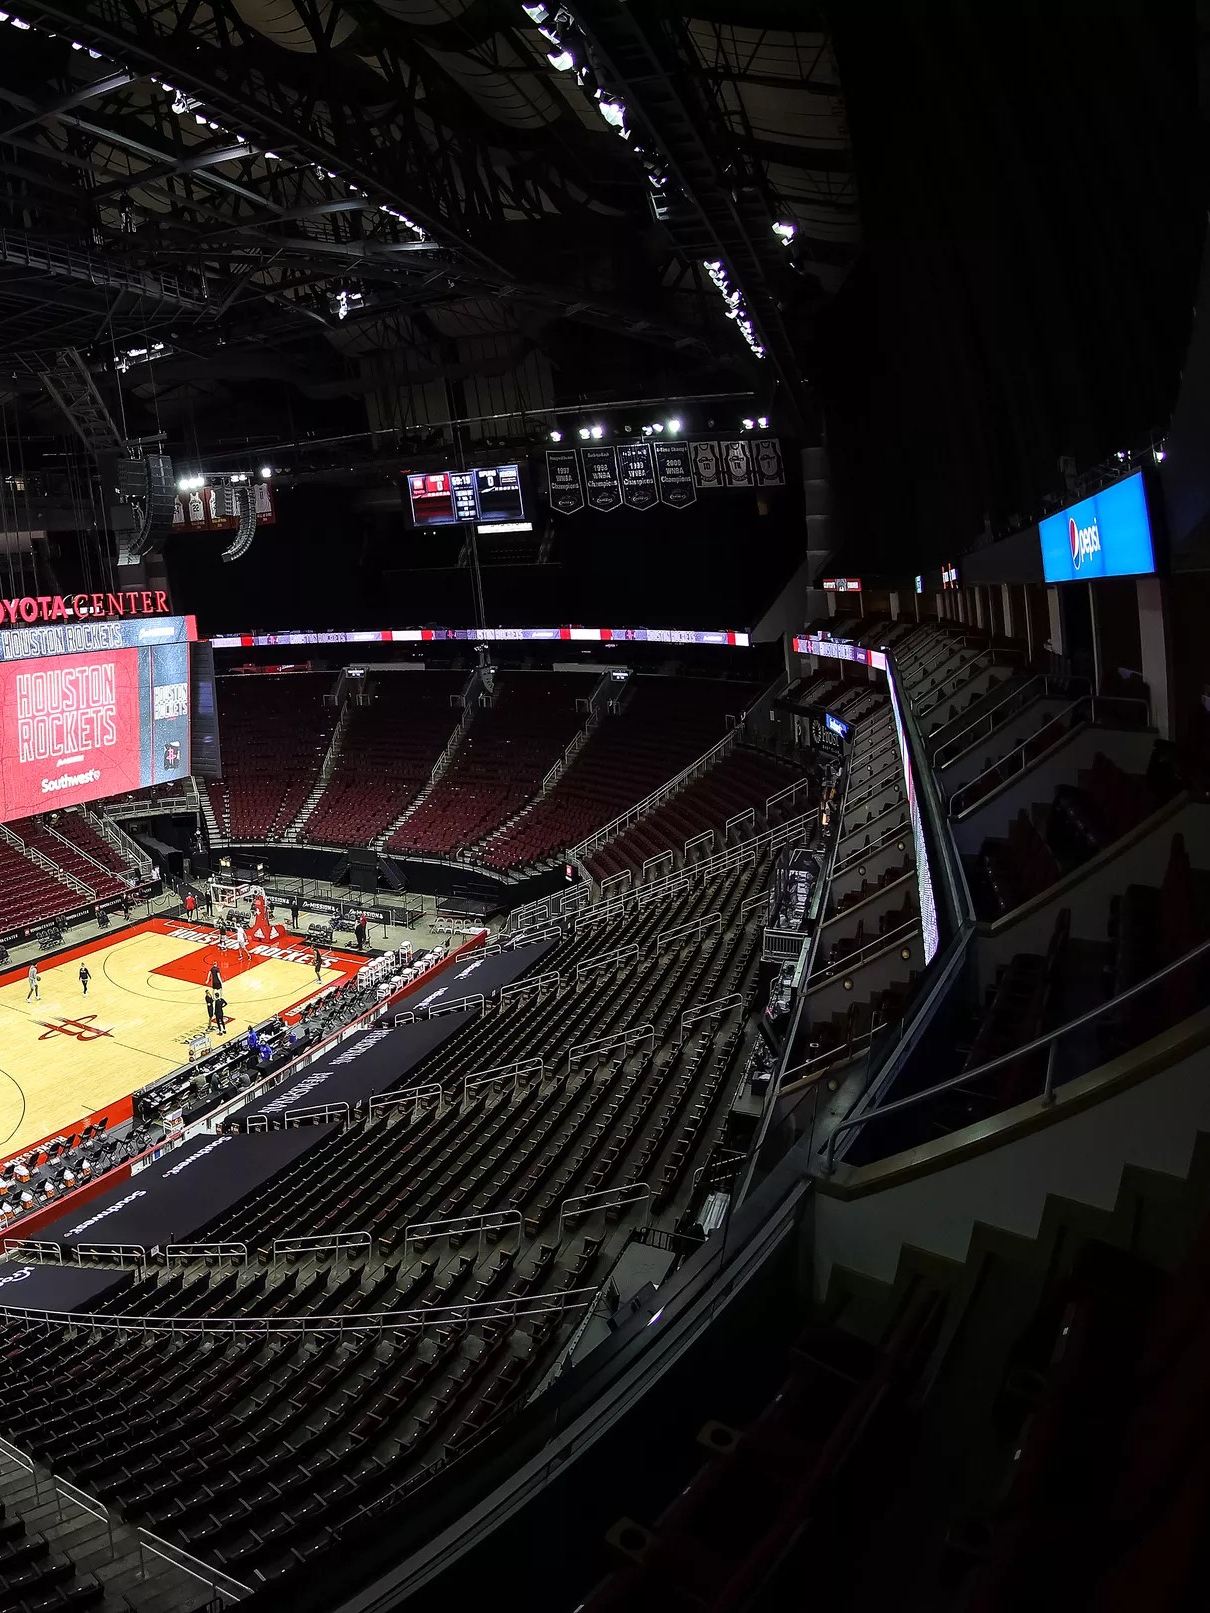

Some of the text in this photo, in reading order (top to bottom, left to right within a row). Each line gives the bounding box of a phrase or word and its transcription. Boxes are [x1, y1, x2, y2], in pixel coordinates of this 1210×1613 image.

[666, 459, 681, 467] 2000
[192, 504, 200, 512] 22
[1079, 517, 1101, 562] pepsi
[73, 590, 170, 619] CENTER
[2, 622, 124, 660] HOUSTON ROCKETS
[16, 663, 115, 719] HOUSTON
[153, 683, 188, 704] HOUSTON
[154, 699, 188, 720] ROCKETS
[19, 705, 117, 763] ROCKETS
[41, 768, 95, 793] Southwest
[41, 921, 55, 930] CENTER
[76, 909, 89, 918] CENTER
[4, 934, 18, 943] CENTER
[249, 945, 339, 968] ROCKES
[170, 1135, 233, 1176] Southwest
[69, 1189, 147, 1236] Southwest
